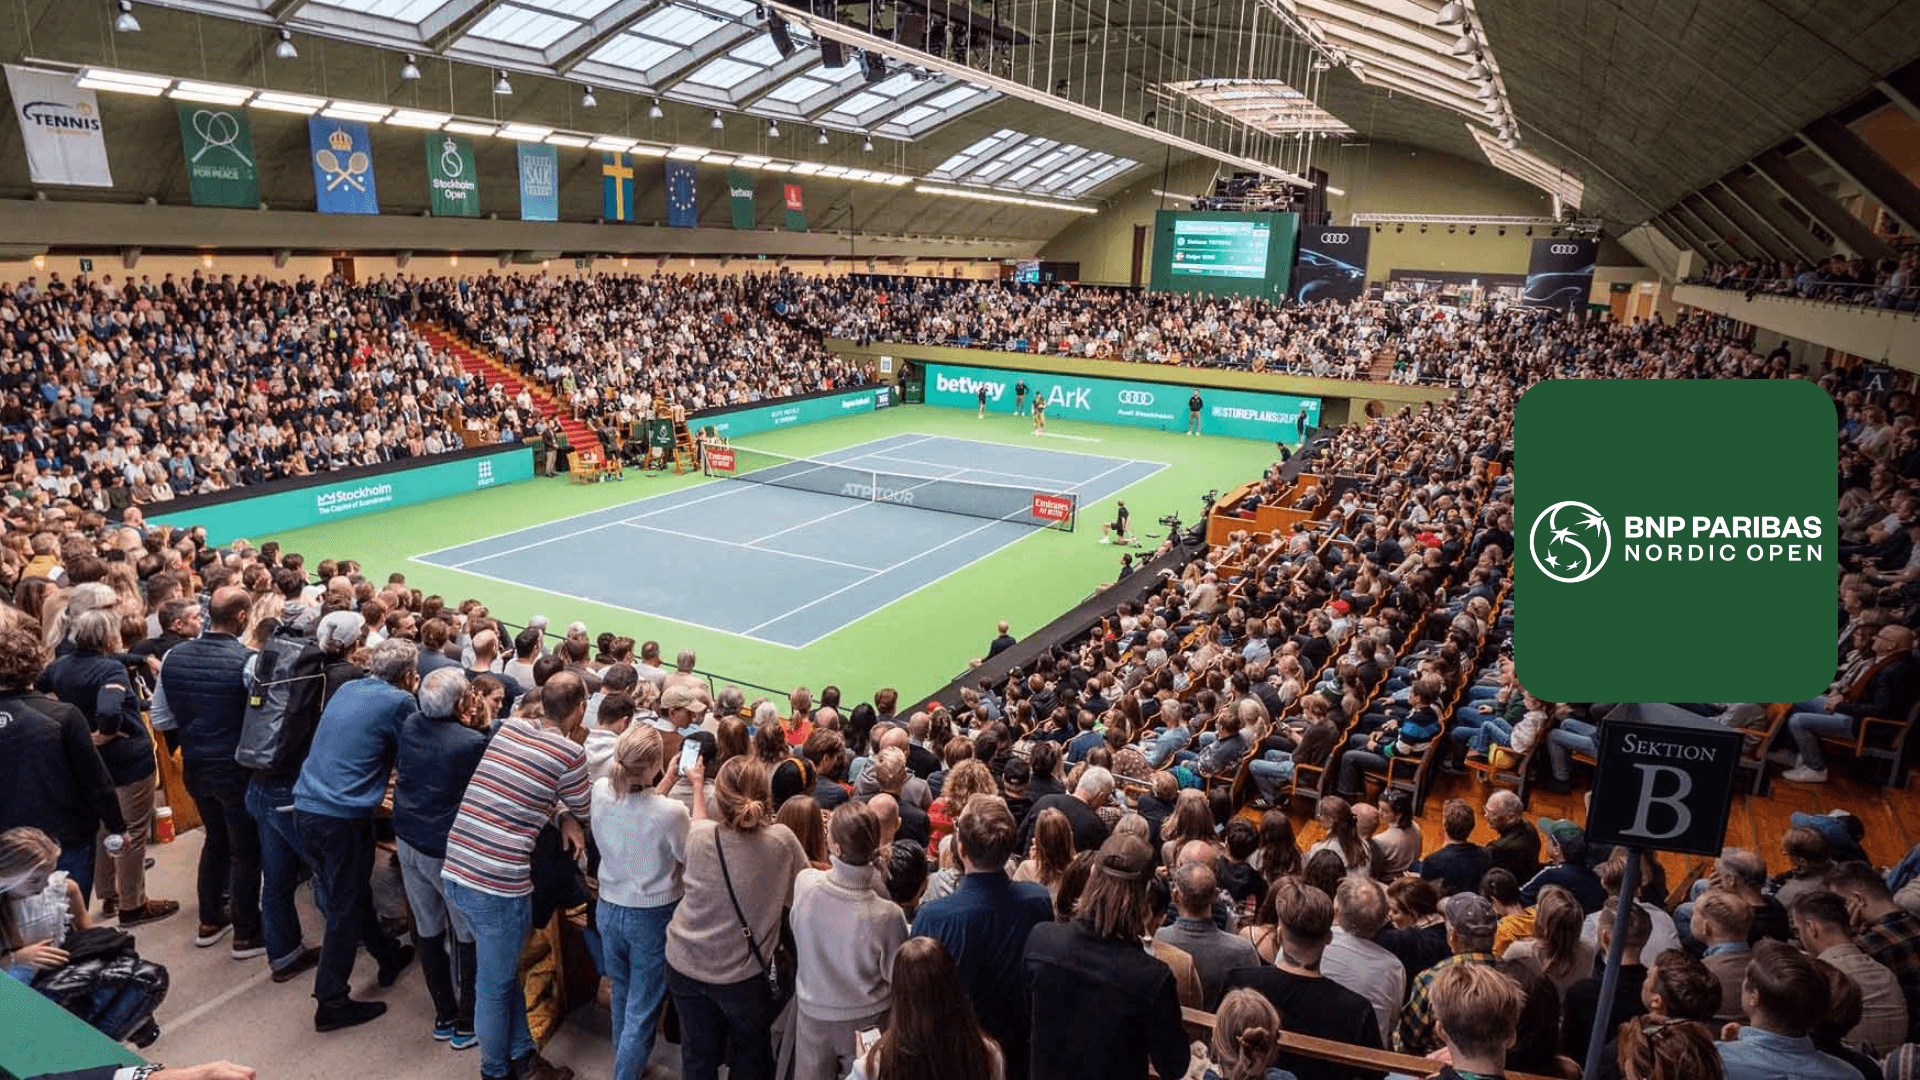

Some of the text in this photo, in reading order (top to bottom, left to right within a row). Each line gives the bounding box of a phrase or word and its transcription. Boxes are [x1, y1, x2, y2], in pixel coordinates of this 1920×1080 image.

[31, 112, 100, 131] TENNIS
[444, 189, 467, 201] Open
[936, 372, 1006, 402] betway
[1866, 373, 1885, 391] A
[336, 483, 392, 503] Stockholm
[1034, 497, 1069, 512] Emirates
[1618, 762, 1694, 840] B
